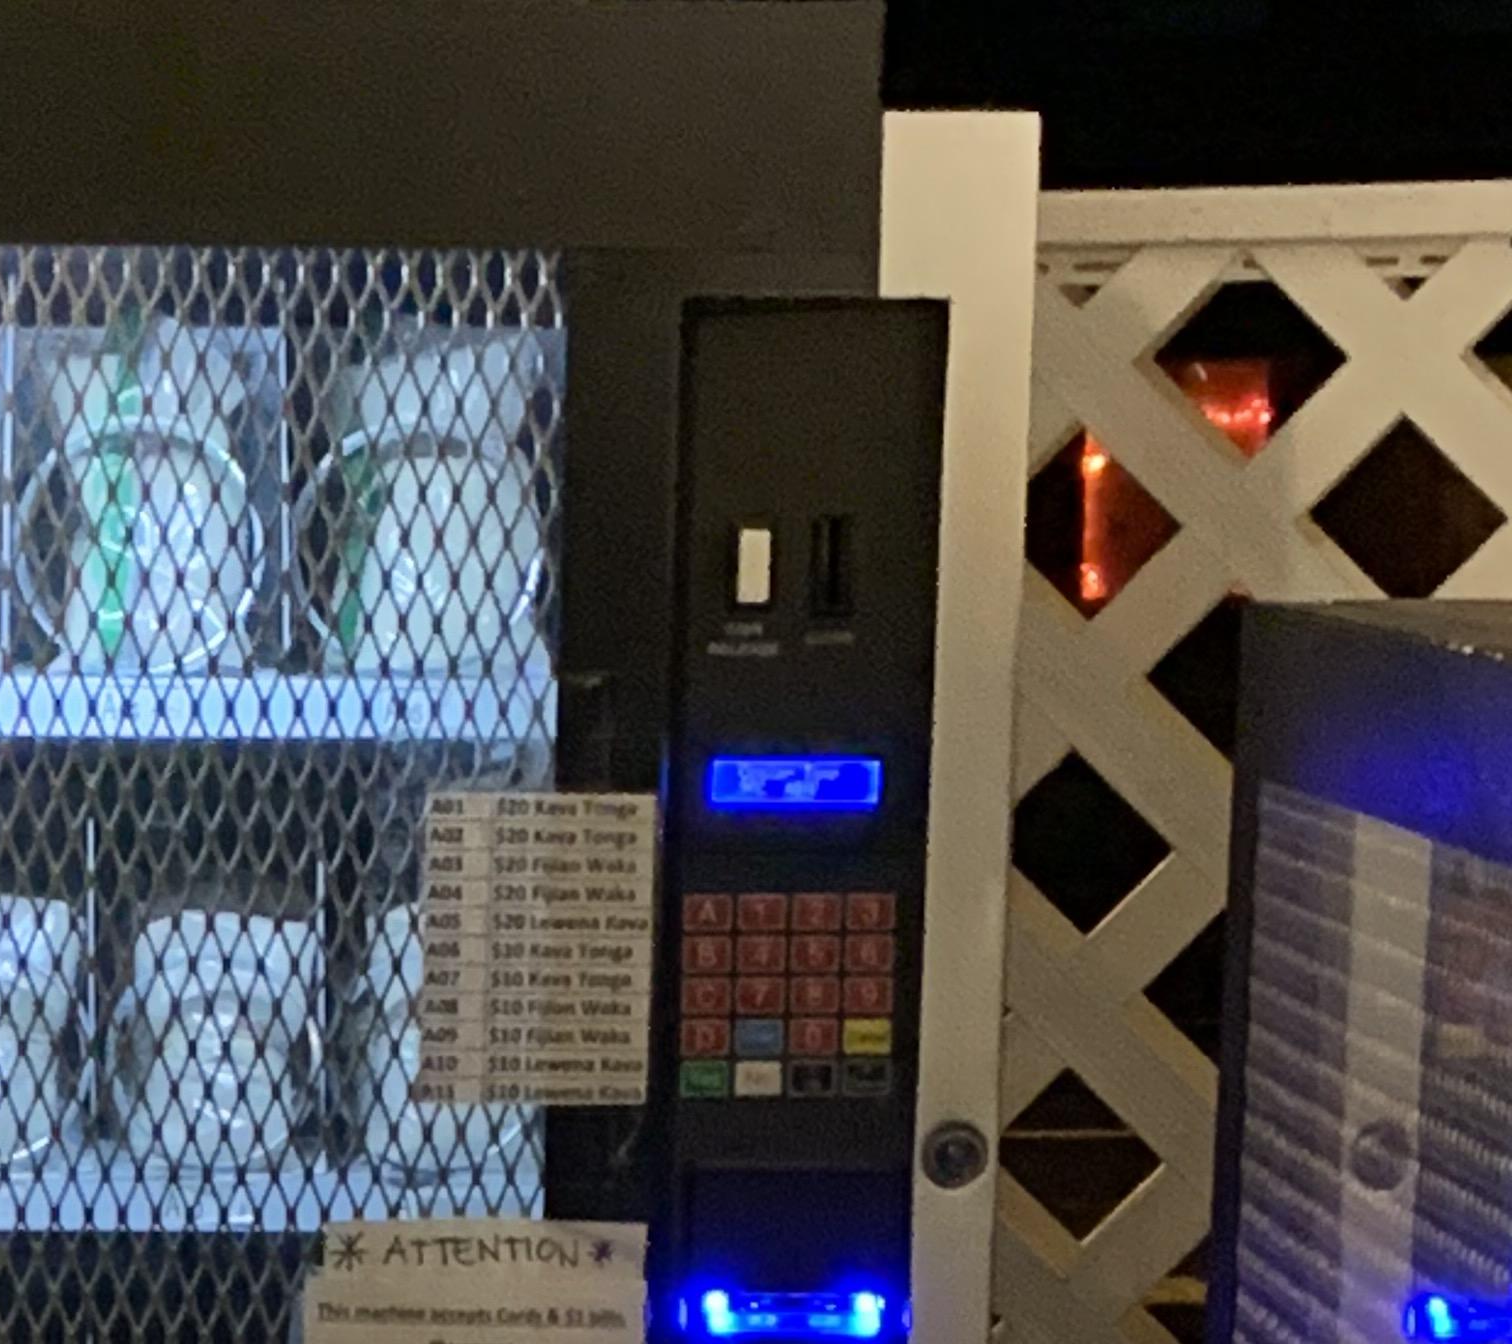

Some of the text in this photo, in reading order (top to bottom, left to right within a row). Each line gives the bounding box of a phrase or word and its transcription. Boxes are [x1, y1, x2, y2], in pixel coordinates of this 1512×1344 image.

[428, 885, 462, 900] A04
[699, 900, 717, 923] A
[809, 900, 823, 924] 2
[861, 901, 880, 923] 3
[426, 914, 461, 928] A05
[697, 941, 717, 967] B
[752, 941, 769, 966] 4
[860, 941, 878, 966] 6
[426, 971, 460, 986] A07
[491, 970, 523, 987] $10
[753, 984, 769, 1008] 7
[861, 983, 879, 1008] 9
[491, 999, 523, 1015] $10
[424, 1028, 458, 1043] A09
[489, 1028, 522, 1044] $10
[581, 1030, 630, 1045] Waka
[421, 1057, 458, 1072] A10
[488, 1056, 521, 1073] $10
[382, 1234, 580, 1267] ATTENTION
[317, 1302, 350, 1322] This
